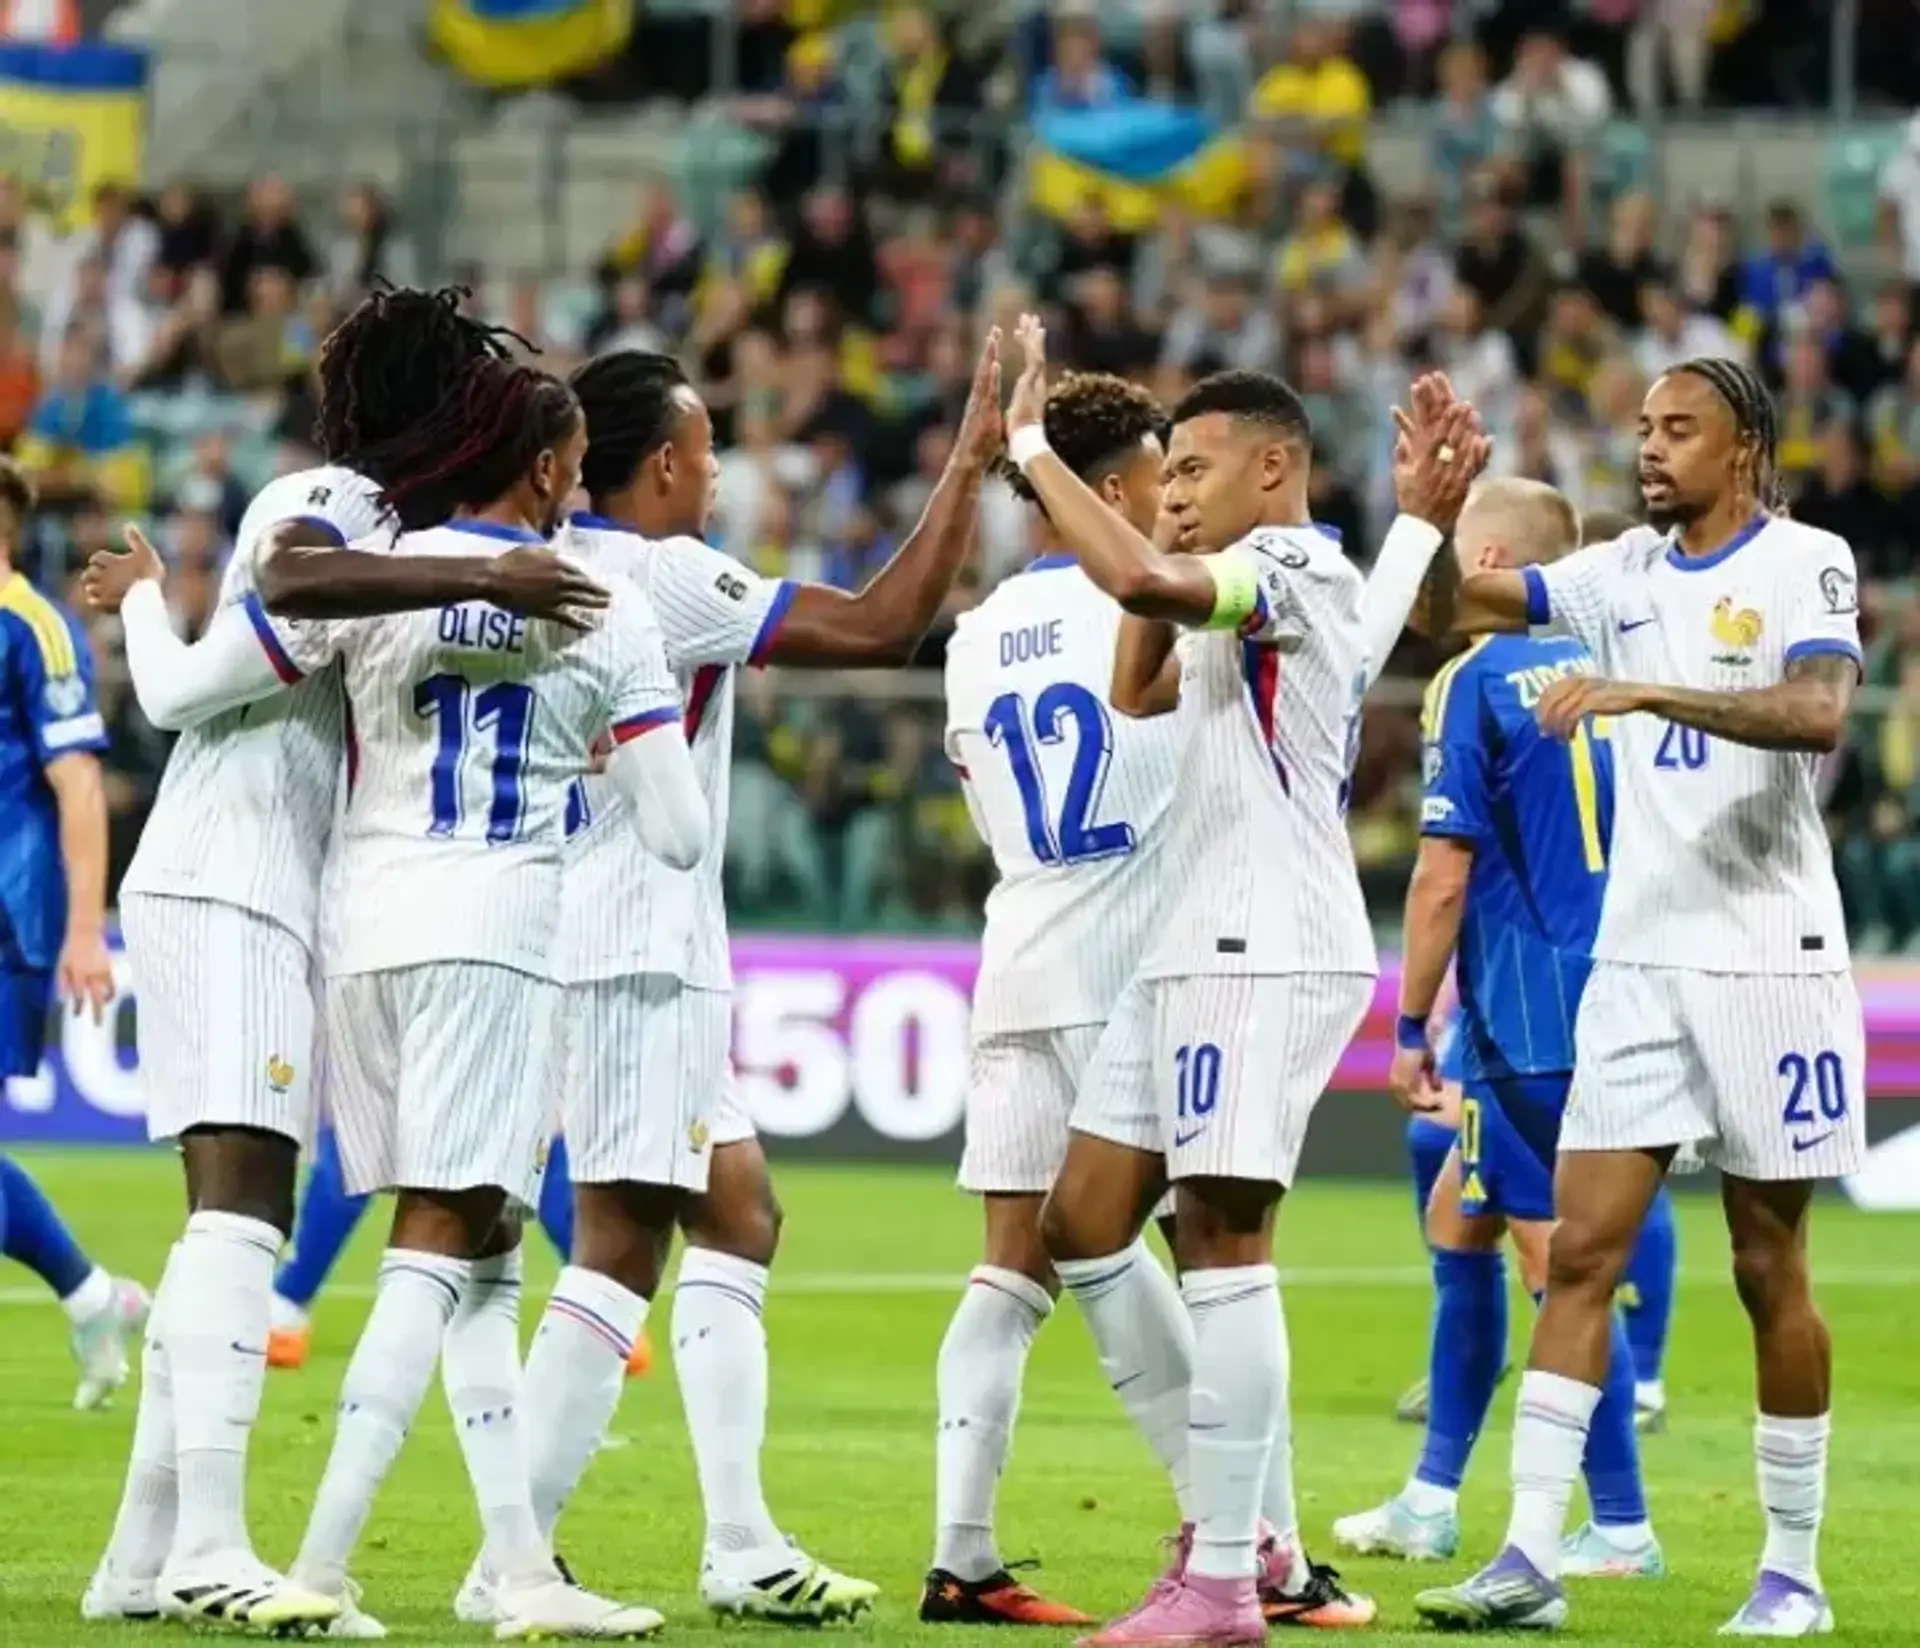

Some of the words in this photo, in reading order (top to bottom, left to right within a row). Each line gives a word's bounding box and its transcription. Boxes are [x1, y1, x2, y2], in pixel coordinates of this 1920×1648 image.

[438, 605, 524, 653] OLISE
[999, 618, 1064, 668] DOUE
[413, 672, 536, 845] 11
[983, 682, 1137, 866] 12
[1174, 1042, 1222, 1116] 10
[1778, 1050, 1846, 1124] 20
